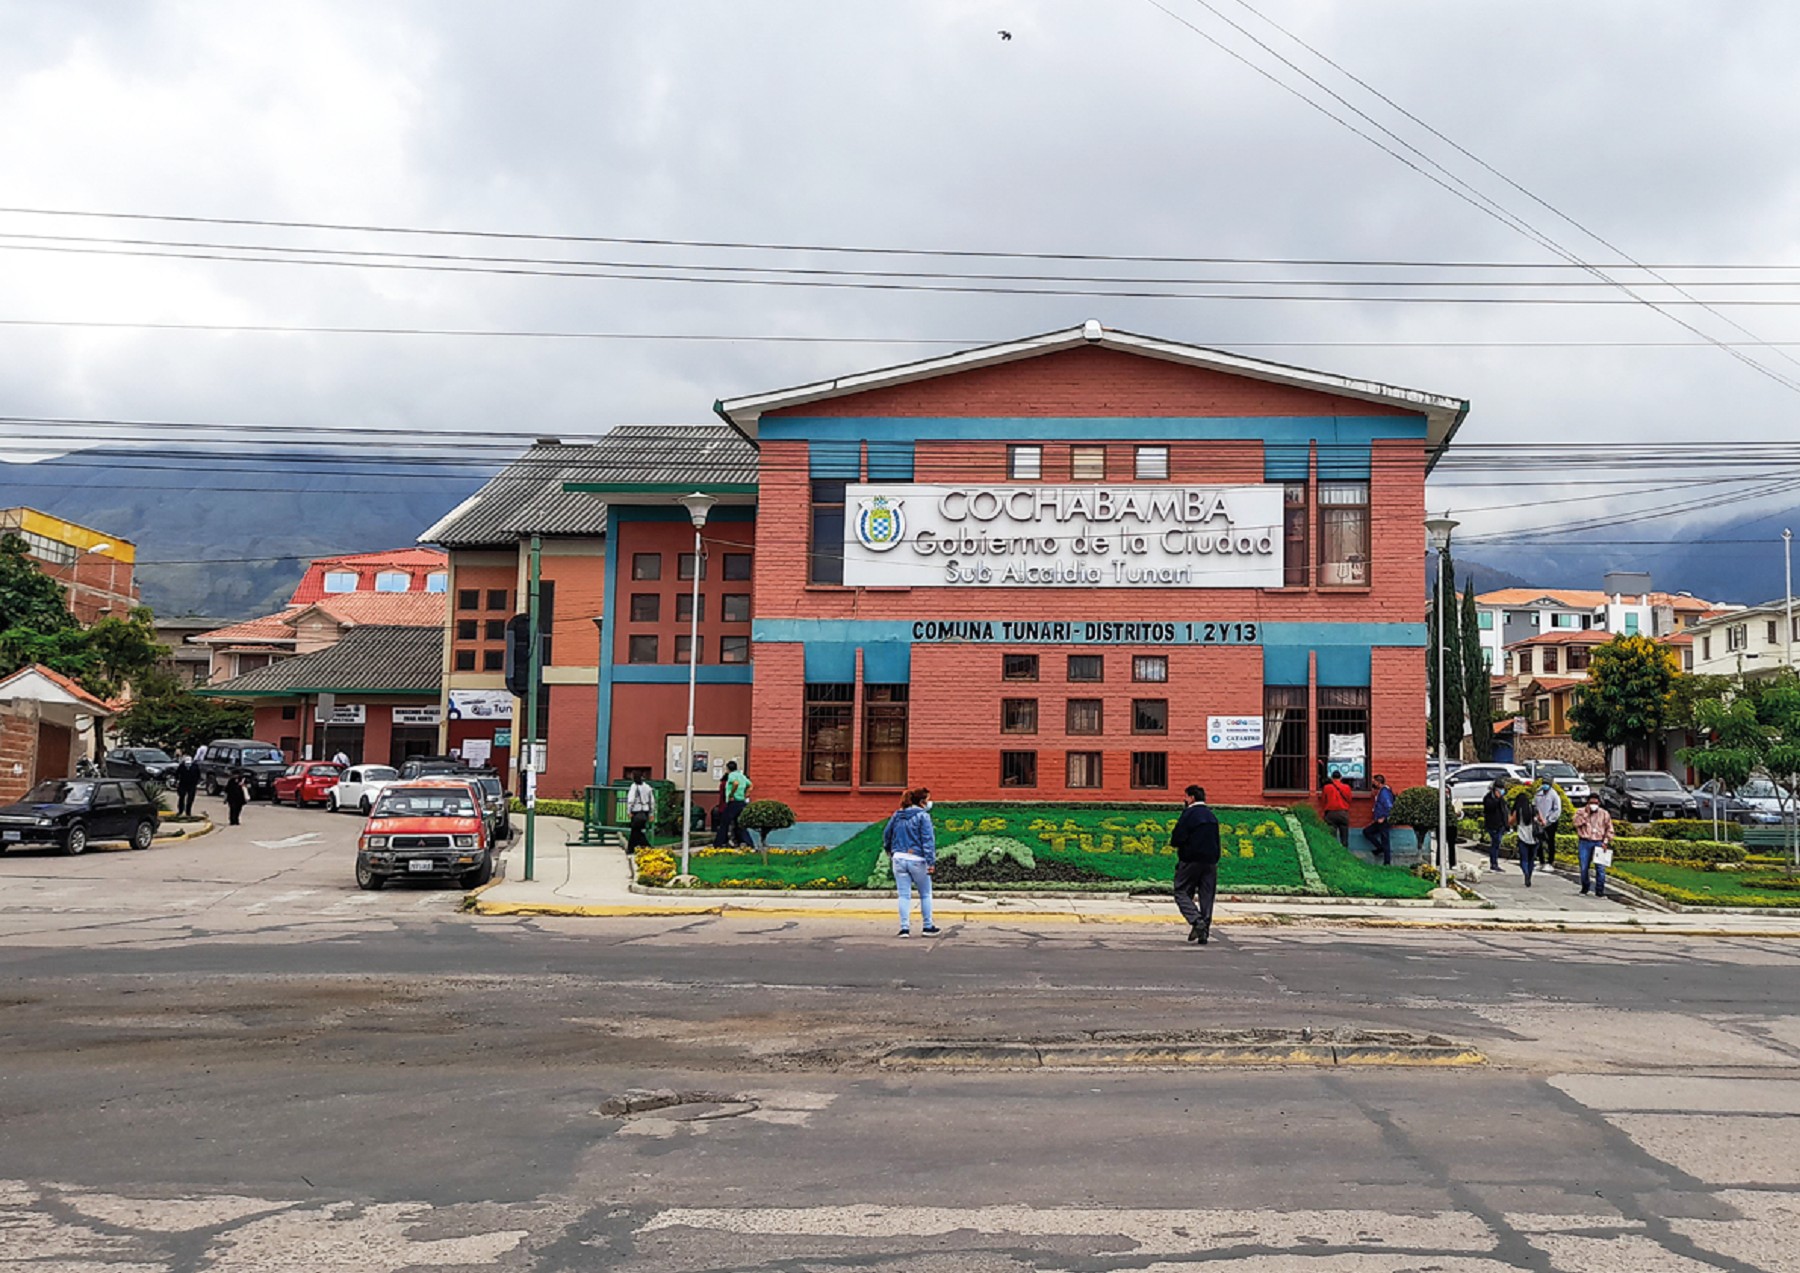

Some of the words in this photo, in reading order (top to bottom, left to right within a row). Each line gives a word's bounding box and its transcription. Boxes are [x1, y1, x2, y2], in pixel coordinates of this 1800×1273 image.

[938, 488, 1234, 523] COCHABAMBA
[911, 527, 1059, 555] Gobierno
[1071, 525, 1110, 554] de
[1120, 525, 1148, 554] la
[1161, 525, 1273, 555] Ciudad
[945, 560, 992, 583] Sub
[1001, 560, 1101, 583] Alcaldia
[1111, 559, 1192, 584] Tunari
[910, 621, 994, 640] COMUNA
[1085, 622, 1175, 641] DISTRITOS
